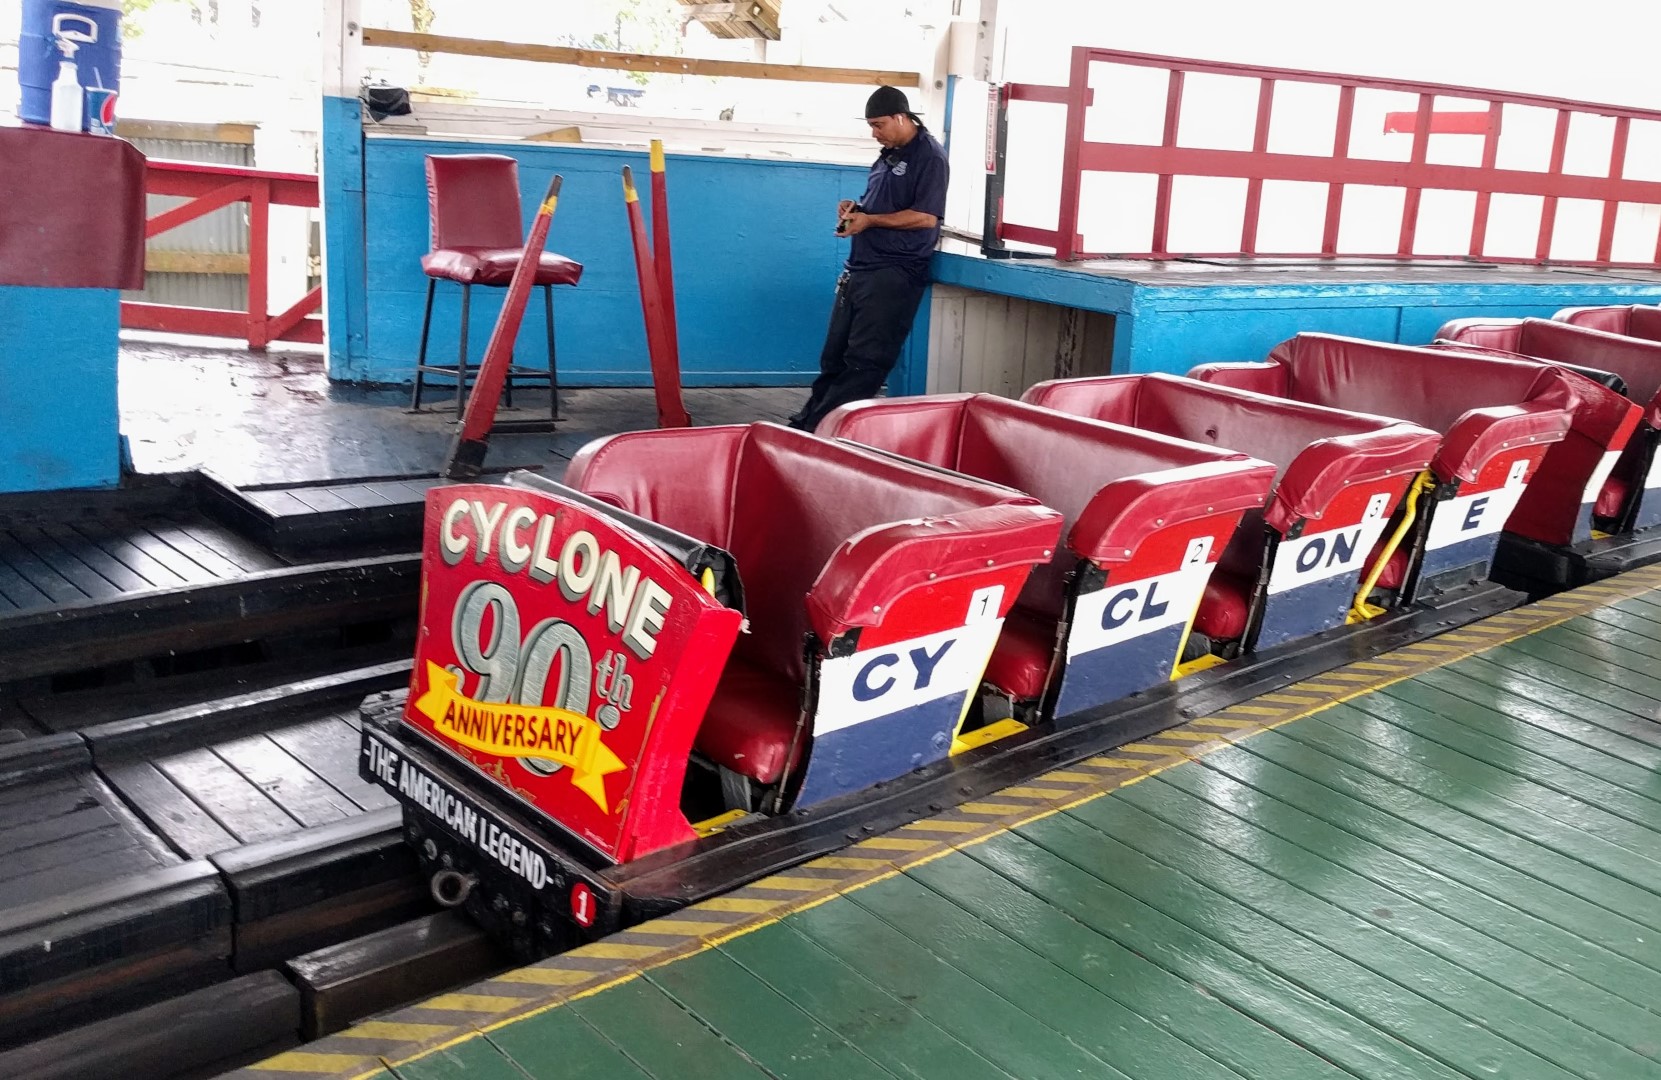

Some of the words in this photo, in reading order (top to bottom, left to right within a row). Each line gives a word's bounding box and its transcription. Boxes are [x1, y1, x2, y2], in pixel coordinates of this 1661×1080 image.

[1461, 496, 1490, 531] E
[1190, 542, 1204, 564] 2
[1296, 529, 1361, 573] ON
[440, 499, 673, 660] CYCLONE
[980, 590, 990, 617] 1
[1101, 582, 1169, 630] CL
[852, 638, 957, 702] CY
[442, 700, 584, 756] ANNIVERSARY
[399, 760, 478, 844] AMERICAN
[576, 890, 589, 924] 1
